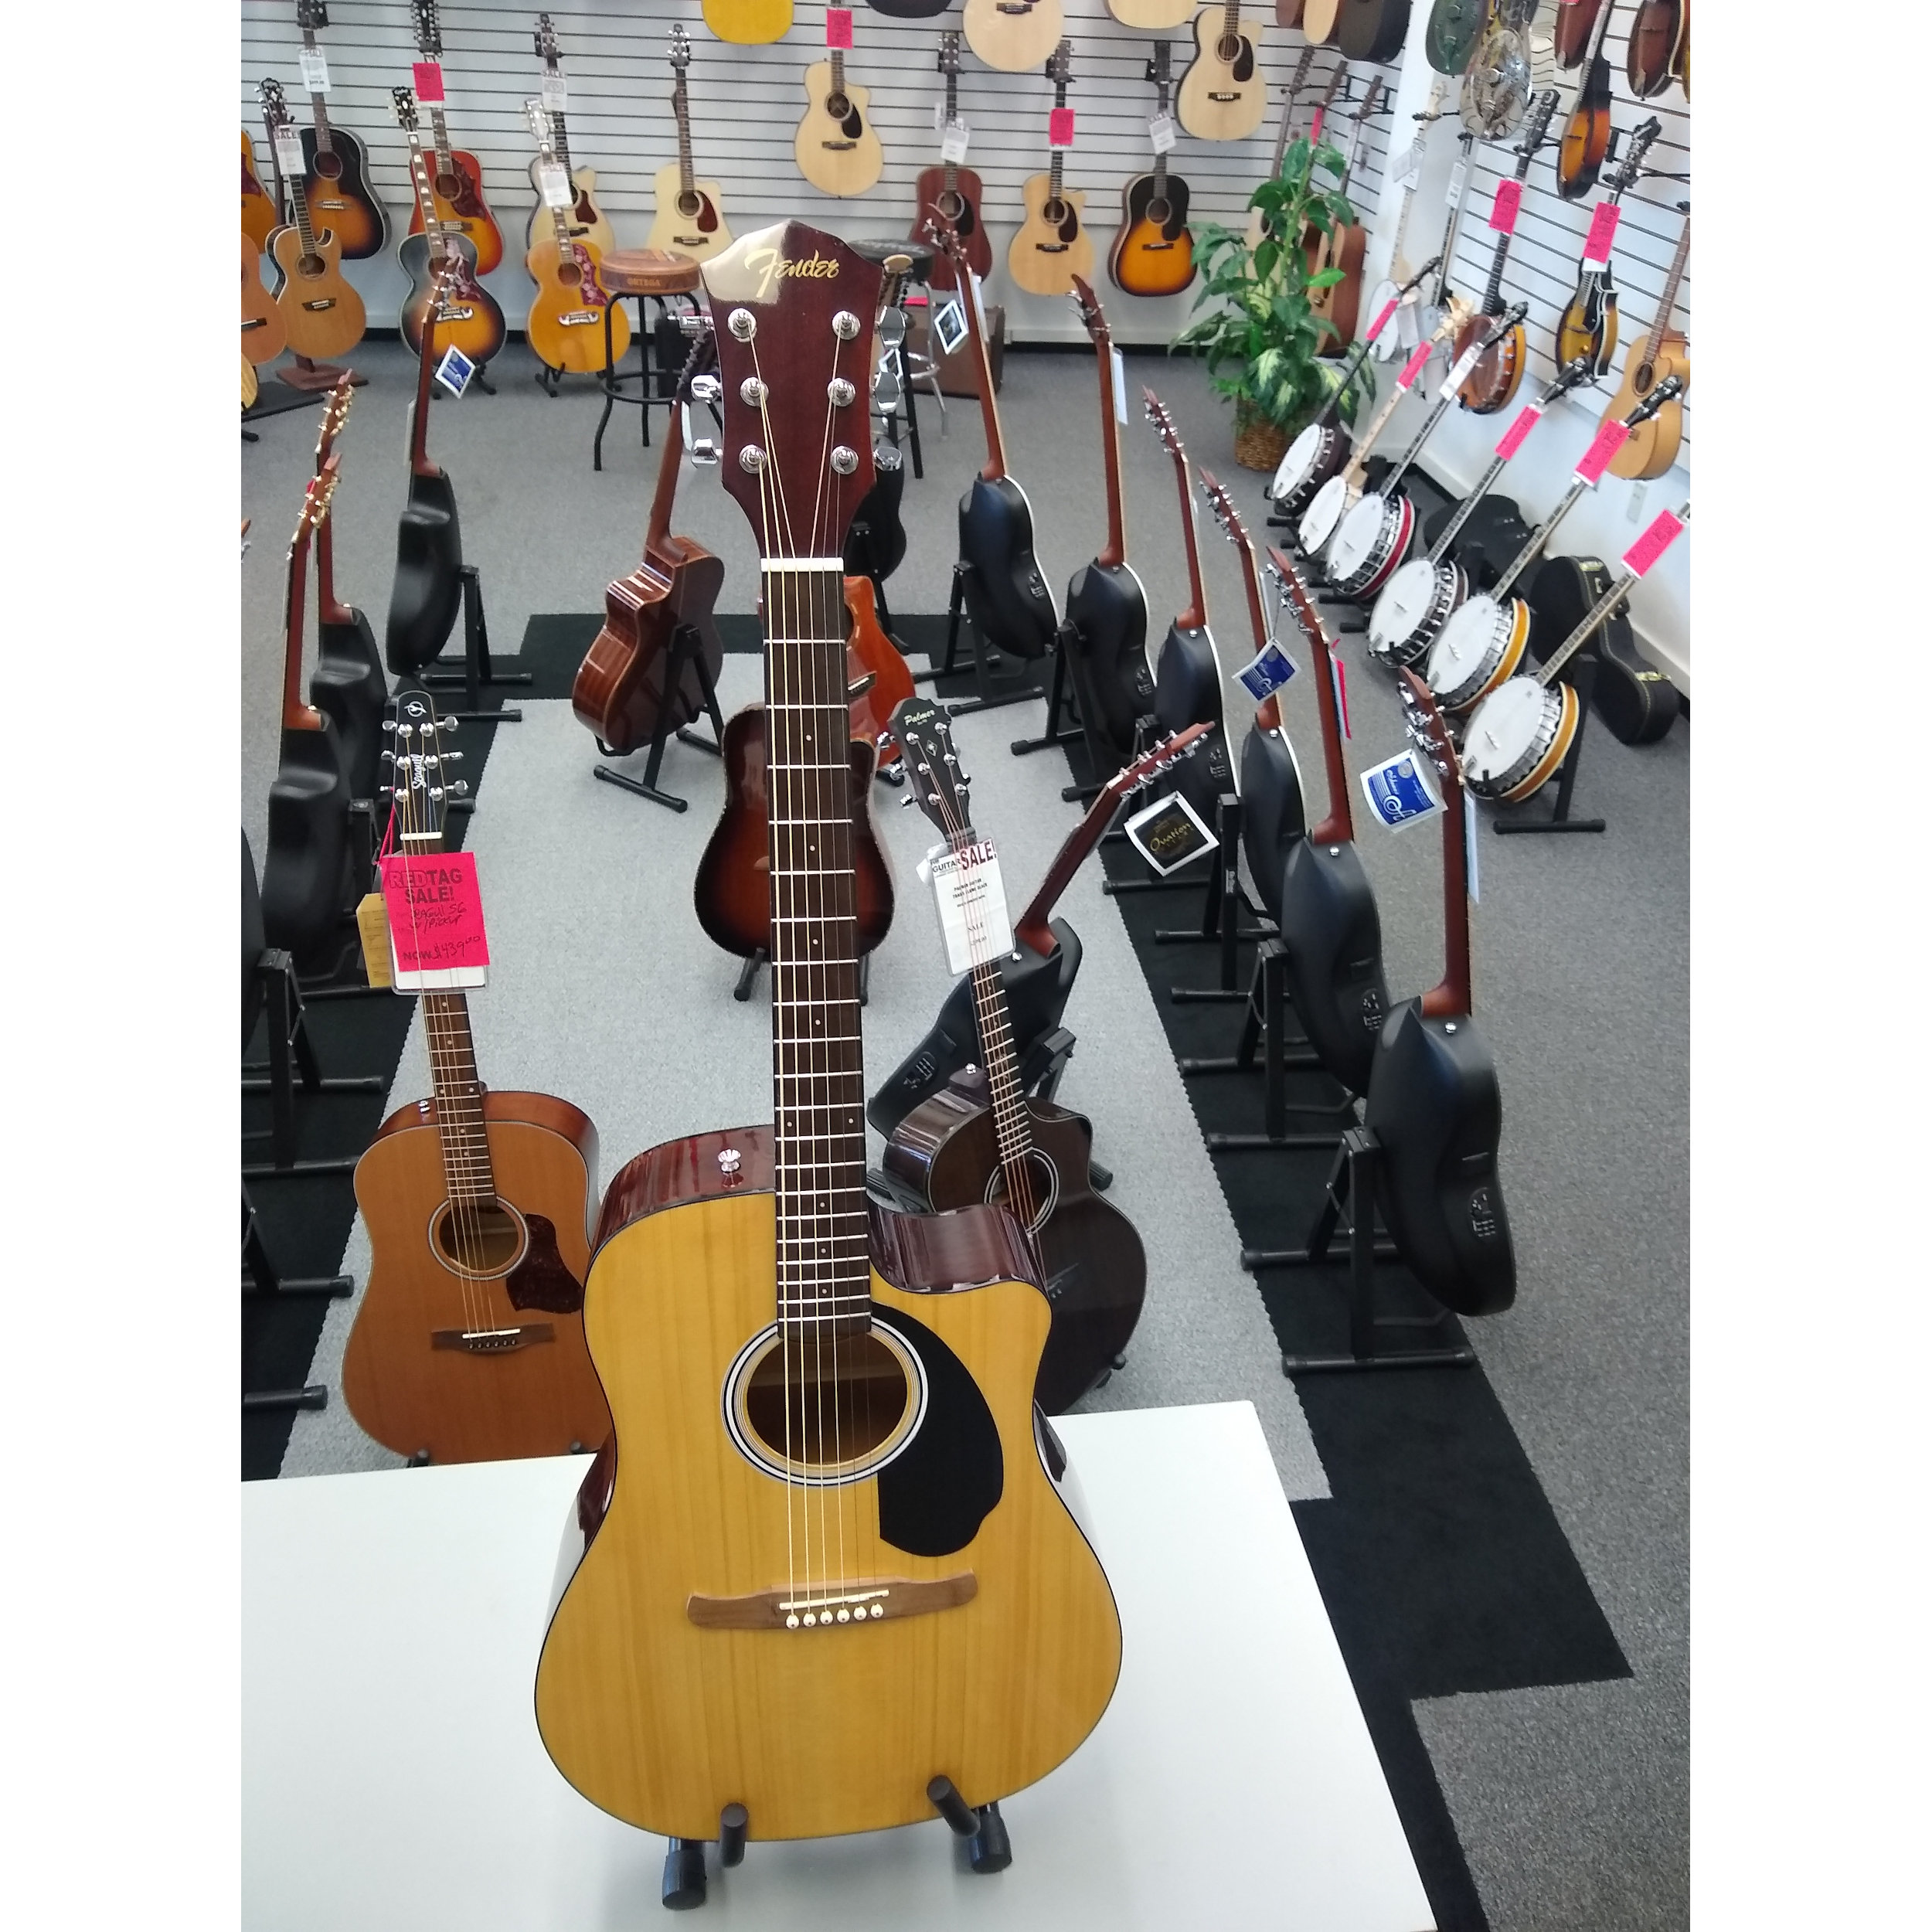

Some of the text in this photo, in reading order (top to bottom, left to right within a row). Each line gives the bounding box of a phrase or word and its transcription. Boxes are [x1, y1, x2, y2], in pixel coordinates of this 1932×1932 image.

[744, 248, 839, 298] Fender
[904, 709, 935, 726] Palmer
[410, 753, 427, 790] Seagull
[1150, 822, 1191, 852] Ovation
[932, 858, 961, 873] GUITAR
[961, 838, 997, 871] SALE!
[405, 886, 454, 905] SALE!
[403, 951, 431, 961] NOW
